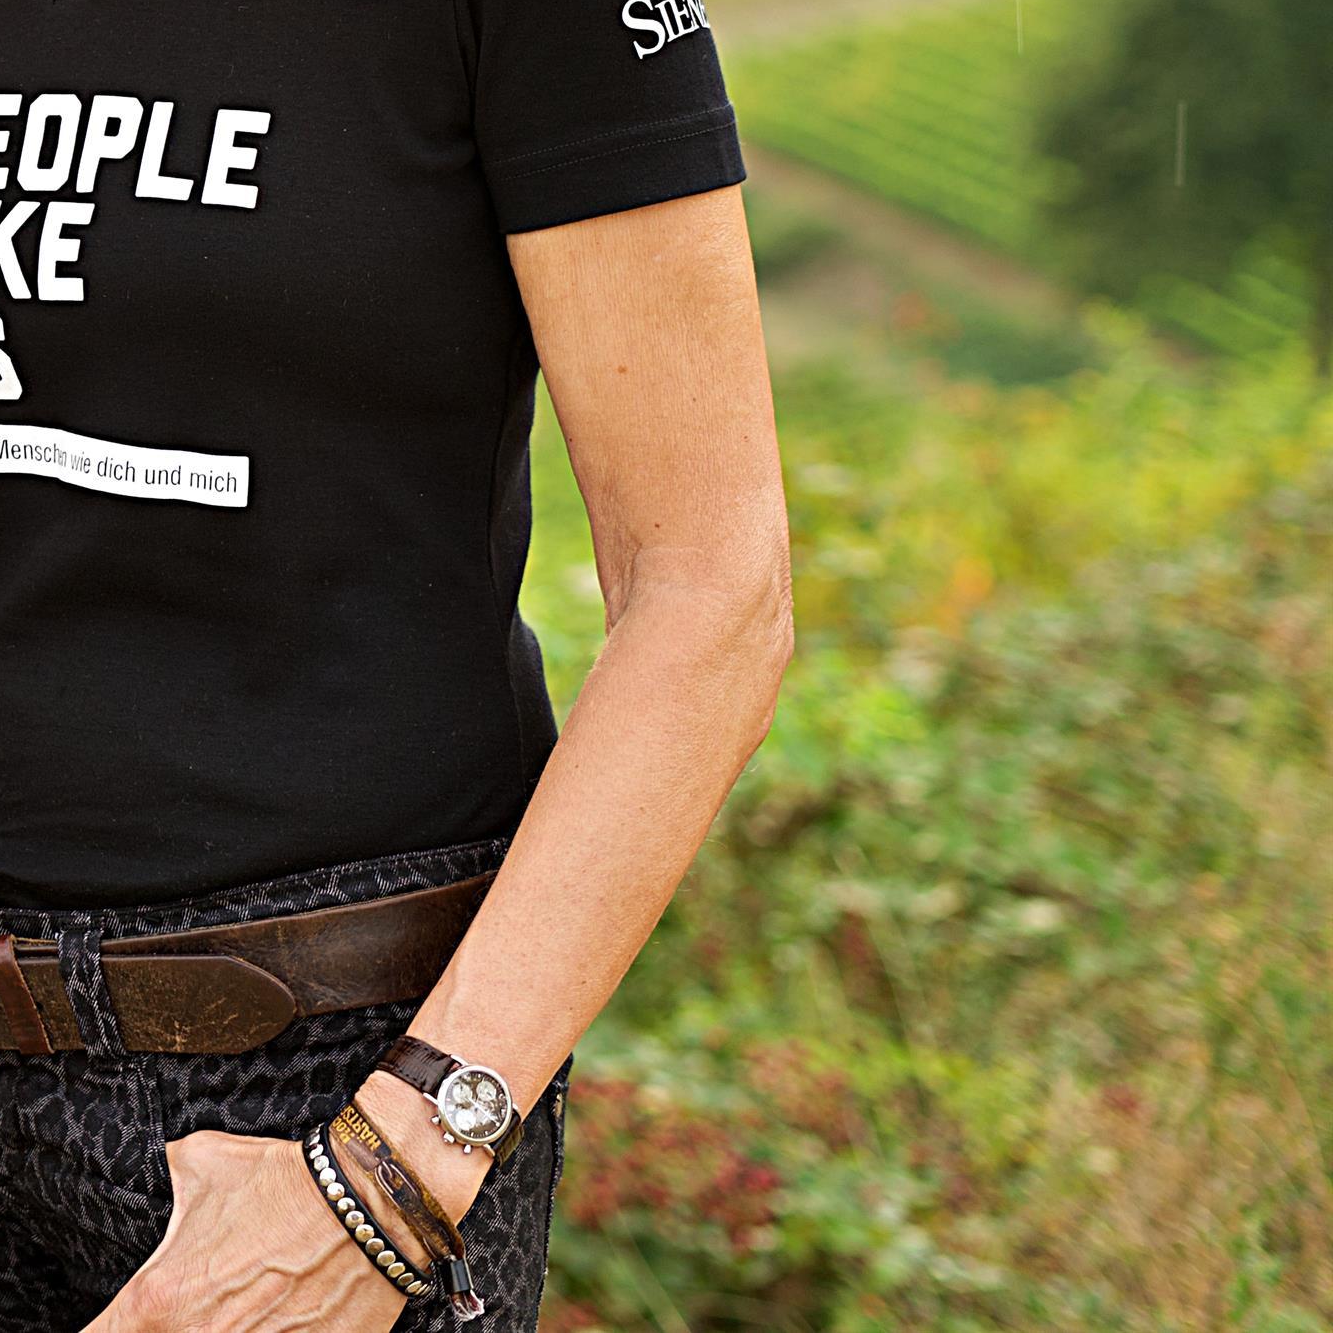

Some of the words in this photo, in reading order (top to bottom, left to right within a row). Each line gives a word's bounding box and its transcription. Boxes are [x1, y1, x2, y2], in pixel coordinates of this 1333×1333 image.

[70, 451, 91, 474] wie
[97, 456, 136, 483] dich
[144, 465, 182, 486] und
[189, 470, 237, 494] mich
